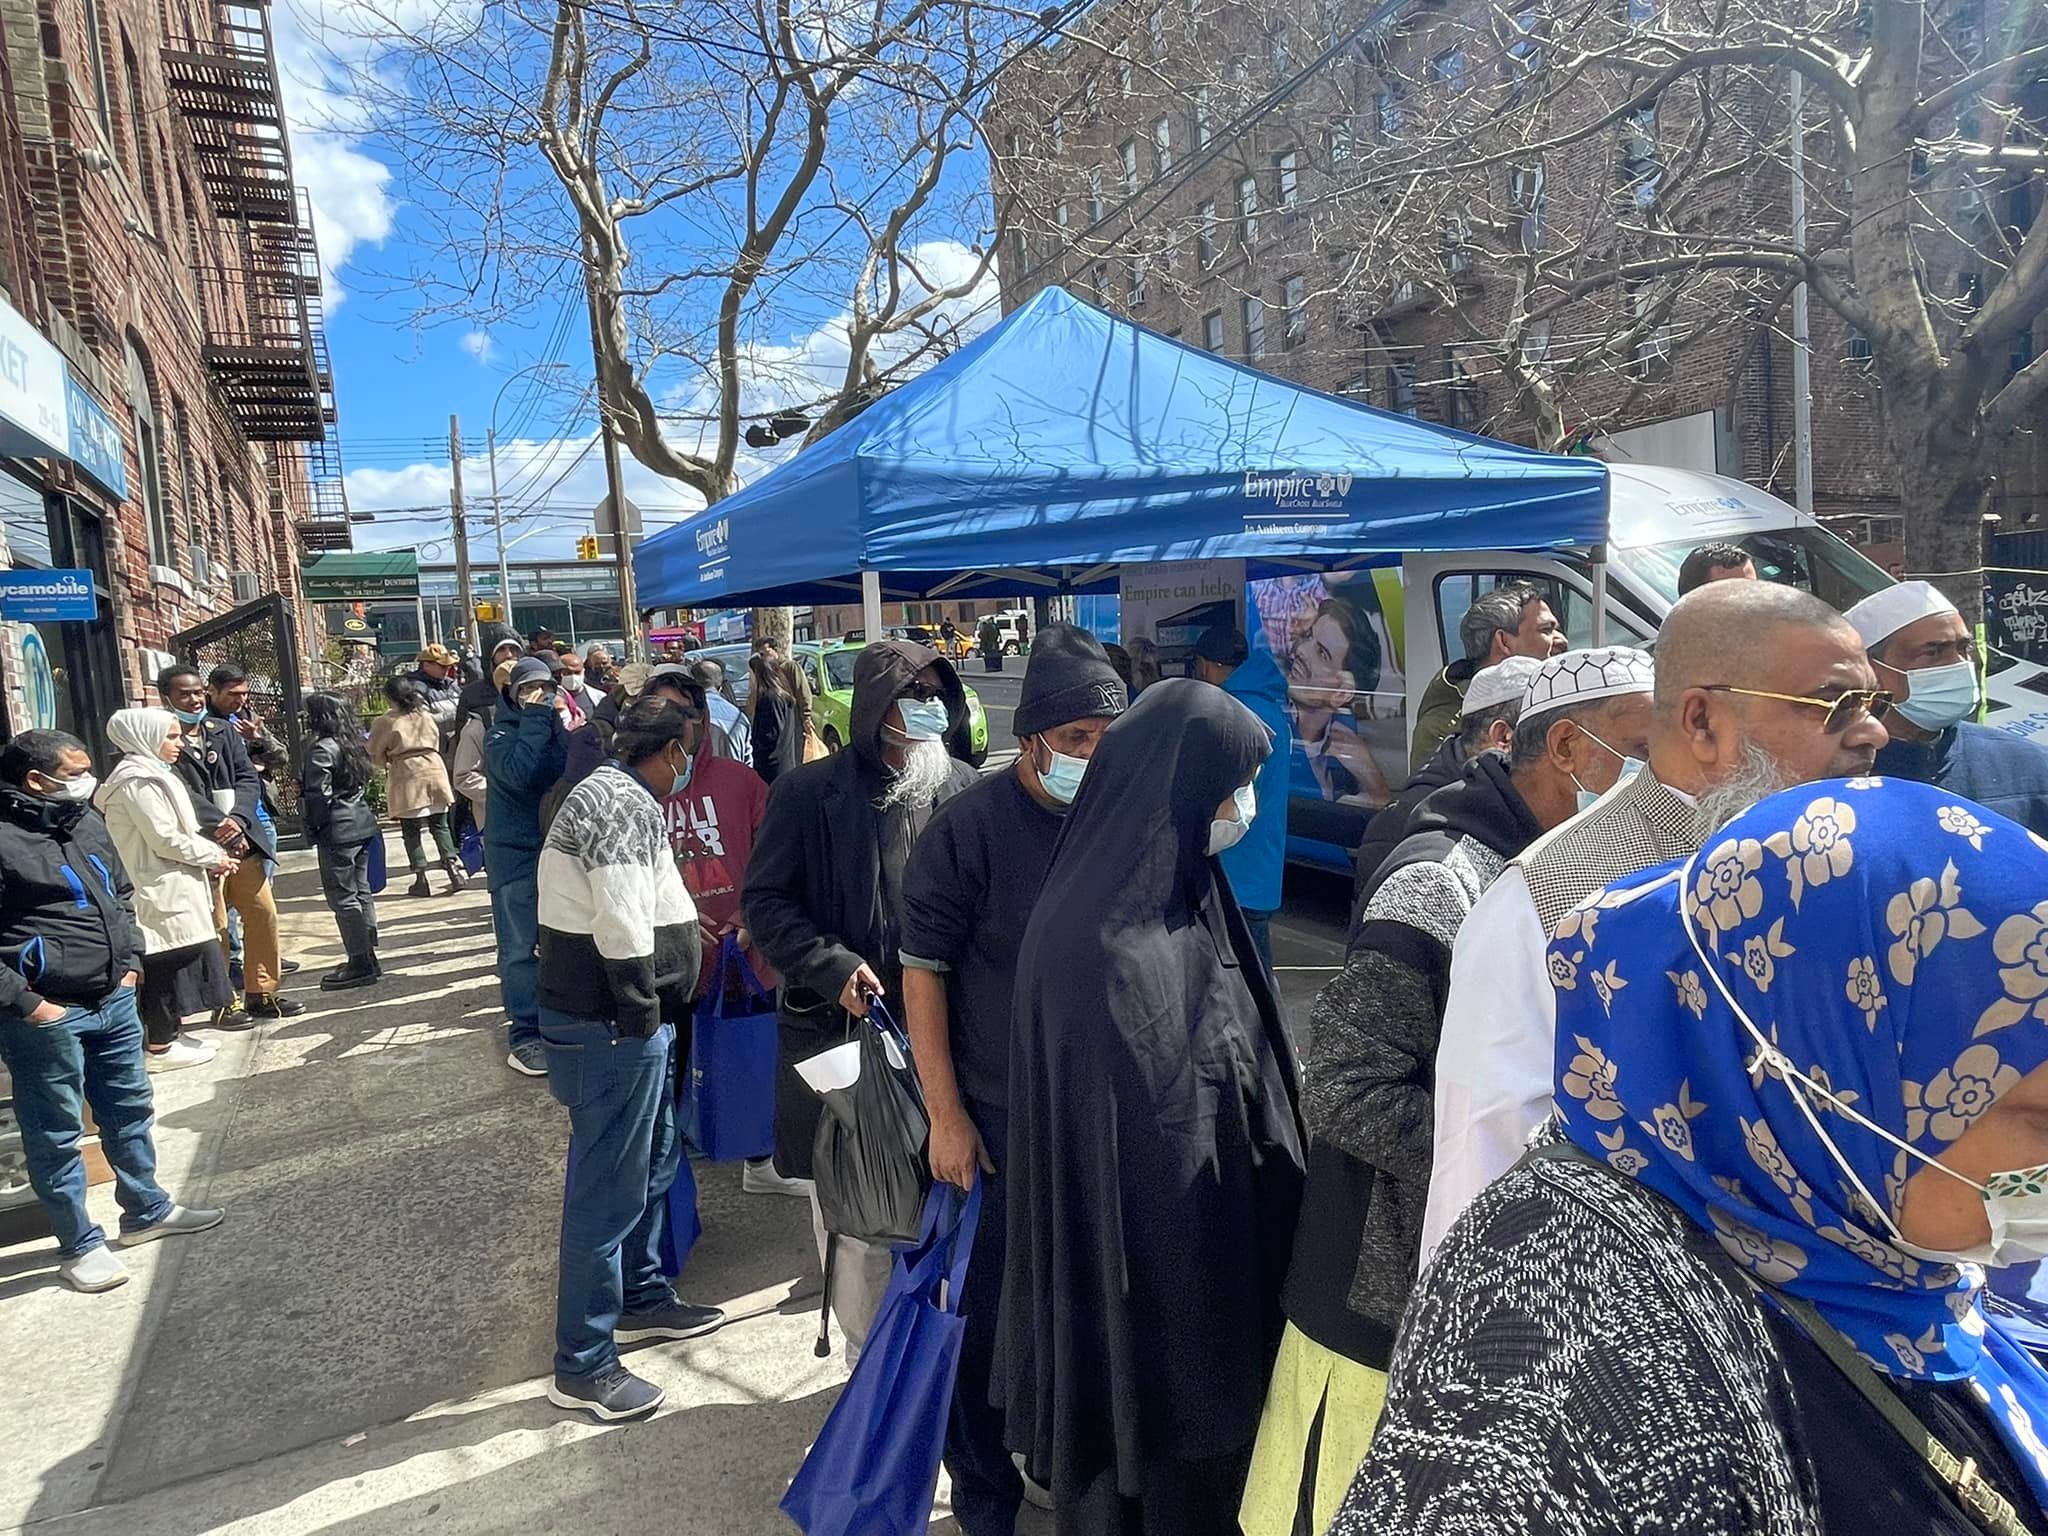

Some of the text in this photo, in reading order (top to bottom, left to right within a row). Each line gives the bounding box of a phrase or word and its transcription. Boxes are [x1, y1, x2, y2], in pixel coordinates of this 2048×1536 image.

[1244, 471, 1314, 505] Empire
[1256, 523, 1294, 535] Anthem
[1124, 584, 1169, 606] Empire
[1174, 587, 1196, 599] can
